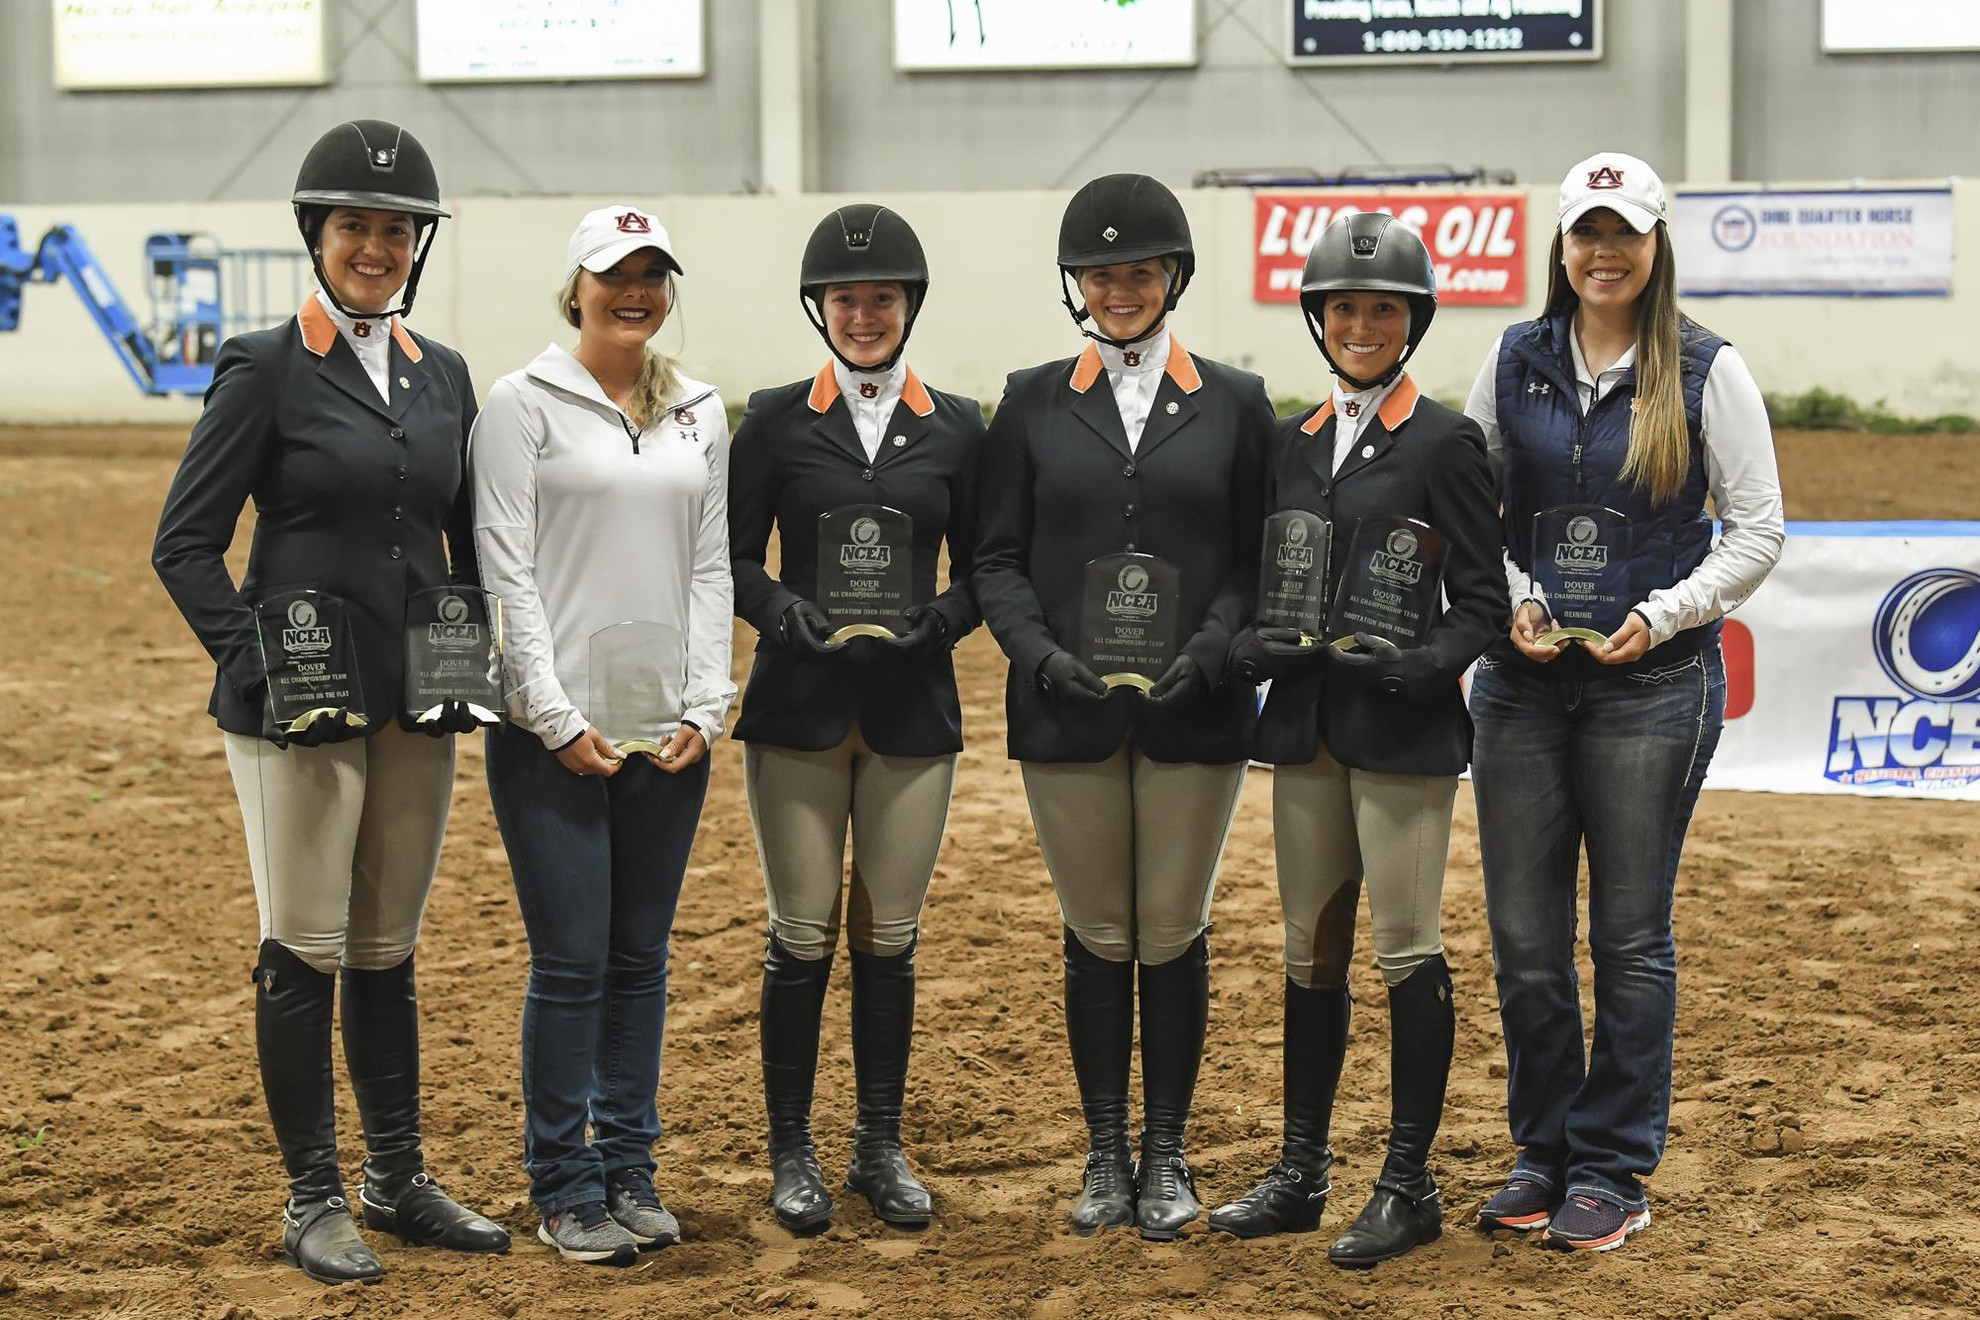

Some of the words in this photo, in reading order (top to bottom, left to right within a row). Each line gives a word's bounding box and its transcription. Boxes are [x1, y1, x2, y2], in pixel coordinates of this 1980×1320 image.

[1798, 209, 1861, 224] QUARTER
[1869, 208, 1912, 224] HORSE
[1434, 206, 1516, 258] OIL
[1760, 229, 1914, 250] FOUNDATION
[842, 546, 889, 561] NCEA
[1278, 546, 1313, 564] NCEA
[1557, 545, 1606, 563] NCEA
[1371, 553, 1422, 579] NCEA
[850, 580, 880, 588] DOVER
[1282, 580, 1303, 590] DOVER
[1564, 581, 1595, 590] DOVER
[1108, 592, 1156, 610] NCEA
[1372, 589, 1402, 603] DOVER
[1554, 592, 1598, 601] CHAMPIONSHIP
[1349, 595, 1359, 603] ALL
[1360, 598, 1403, 614] CHAMPIONSHIP
[1404, 610, 1420, 620] TEAM
[1564, 611, 1592, 619] REINING
[1115, 627, 1145, 635] DOVER
[1344, 611, 1377, 626] EQUITATION
[1378, 621, 1393, 631] OVER
[1394, 625, 1416, 637] FENCES
[284, 628, 330, 647] NCEA
[430, 624, 478, 640] NCEA
[298, 663, 326, 673] DOVER
[439, 659, 470, 668] DOVER
[332, 673, 347, 681] TEAM
